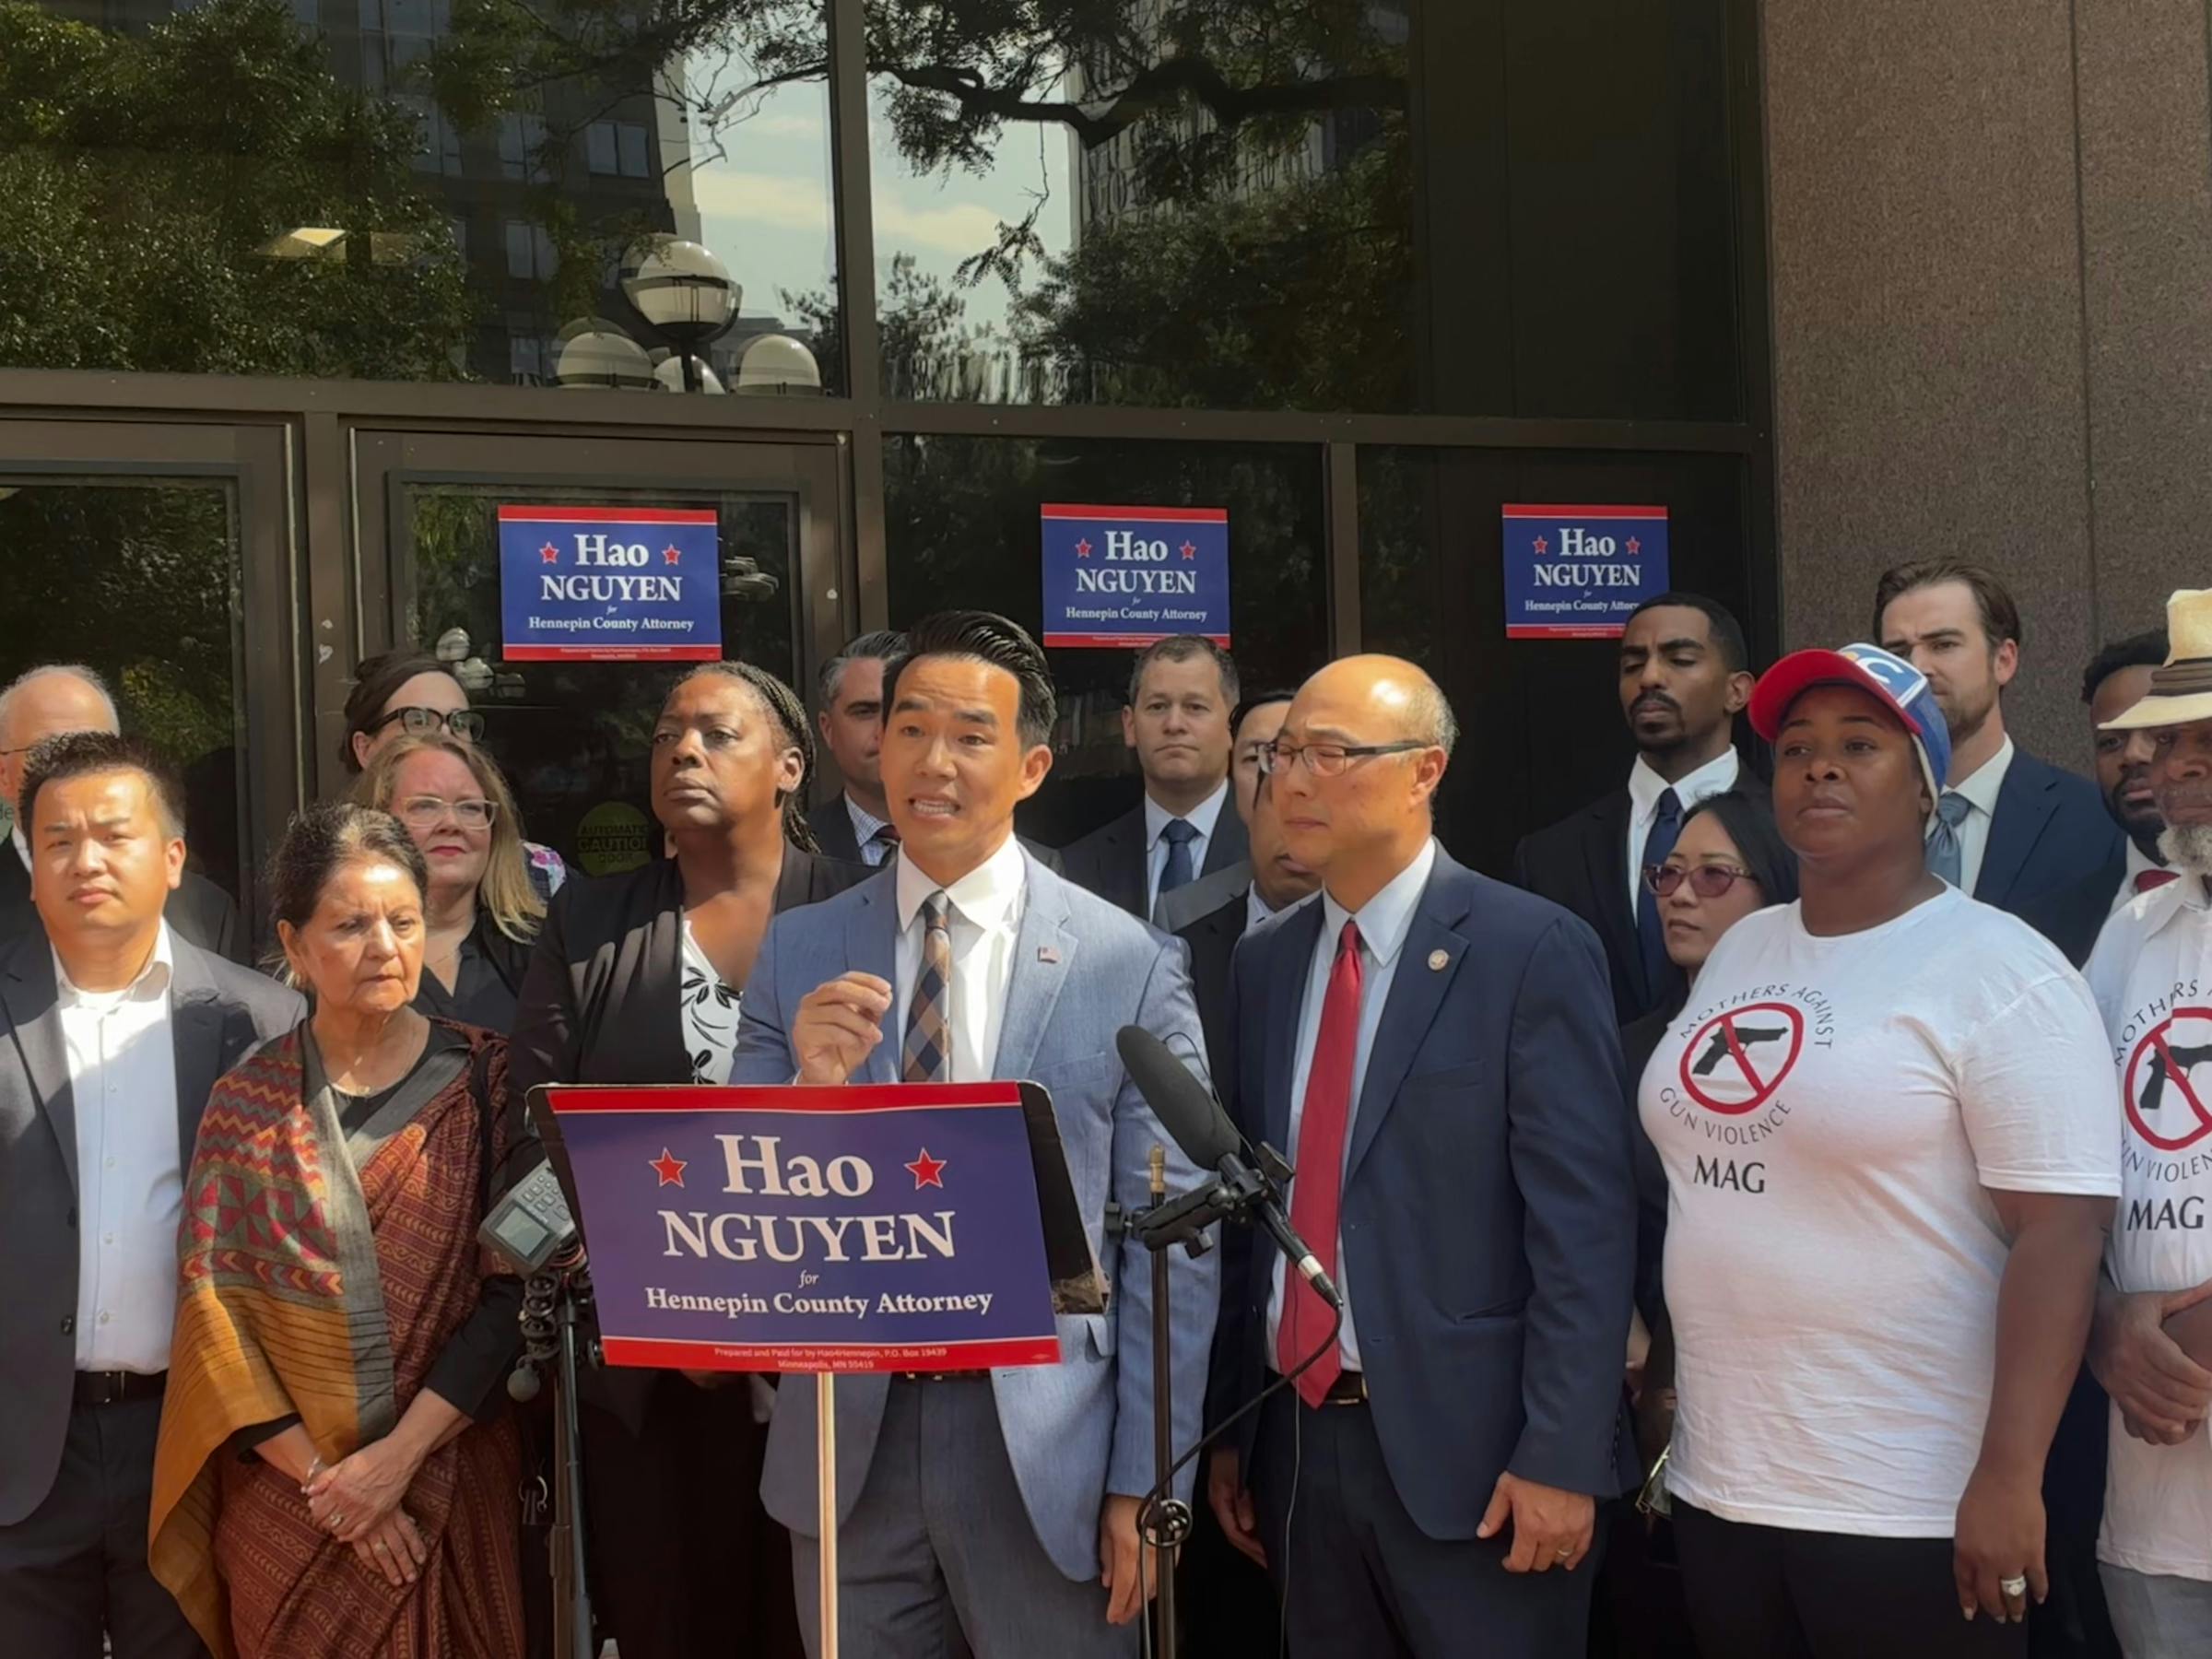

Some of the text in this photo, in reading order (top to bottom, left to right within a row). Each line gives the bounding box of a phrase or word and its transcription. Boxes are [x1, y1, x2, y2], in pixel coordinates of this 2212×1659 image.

[573, 534, 649, 568] Hao
[1104, 530, 1169, 561] Hao
[1559, 528, 1616, 557] Hao
[540, 575, 683, 601] NGUYEN
[1076, 568, 1197, 594] NGUYEN
[1534, 564, 1641, 586] NGUYEN
[1131, 596, 1141, 606] for
[1525, 600, 1572, 614] Hennepin
[1572, 600, 1609, 613] County
[1583, 590, 1593, 599] for
[606, 605, 618, 615] for
[1065, 606, 1207, 622] Hennepin County Attorney
[528, 617, 695, 632] Hennepin County Attorney
[1680, 983, 1834, 1050] MOTHERS AGAINST
[1660, 1088, 1791, 1145] GUN VIOLENCE
[714, 1134, 874, 1197] Hao
[1693, 1155, 1766, 1194] MAG
[2126, 1196, 2205, 1231] MAG
[657, 1210, 956, 1262] NGUYEN
[798, 1269, 819, 1288] for
[645, 1287, 994, 1319] Hennepin County Attorney
[714, 1348, 753, 1358] Prepared
[771, 1348, 791, 1358] Paid
[805, 1348, 816, 1359] by
[884, 1349, 902, 1358] P.O.
[902, 1348, 920, 1358] Box
[777, 1359, 831, 1370] Minneapolis,
[832, 1359, 847, 1370] MN
